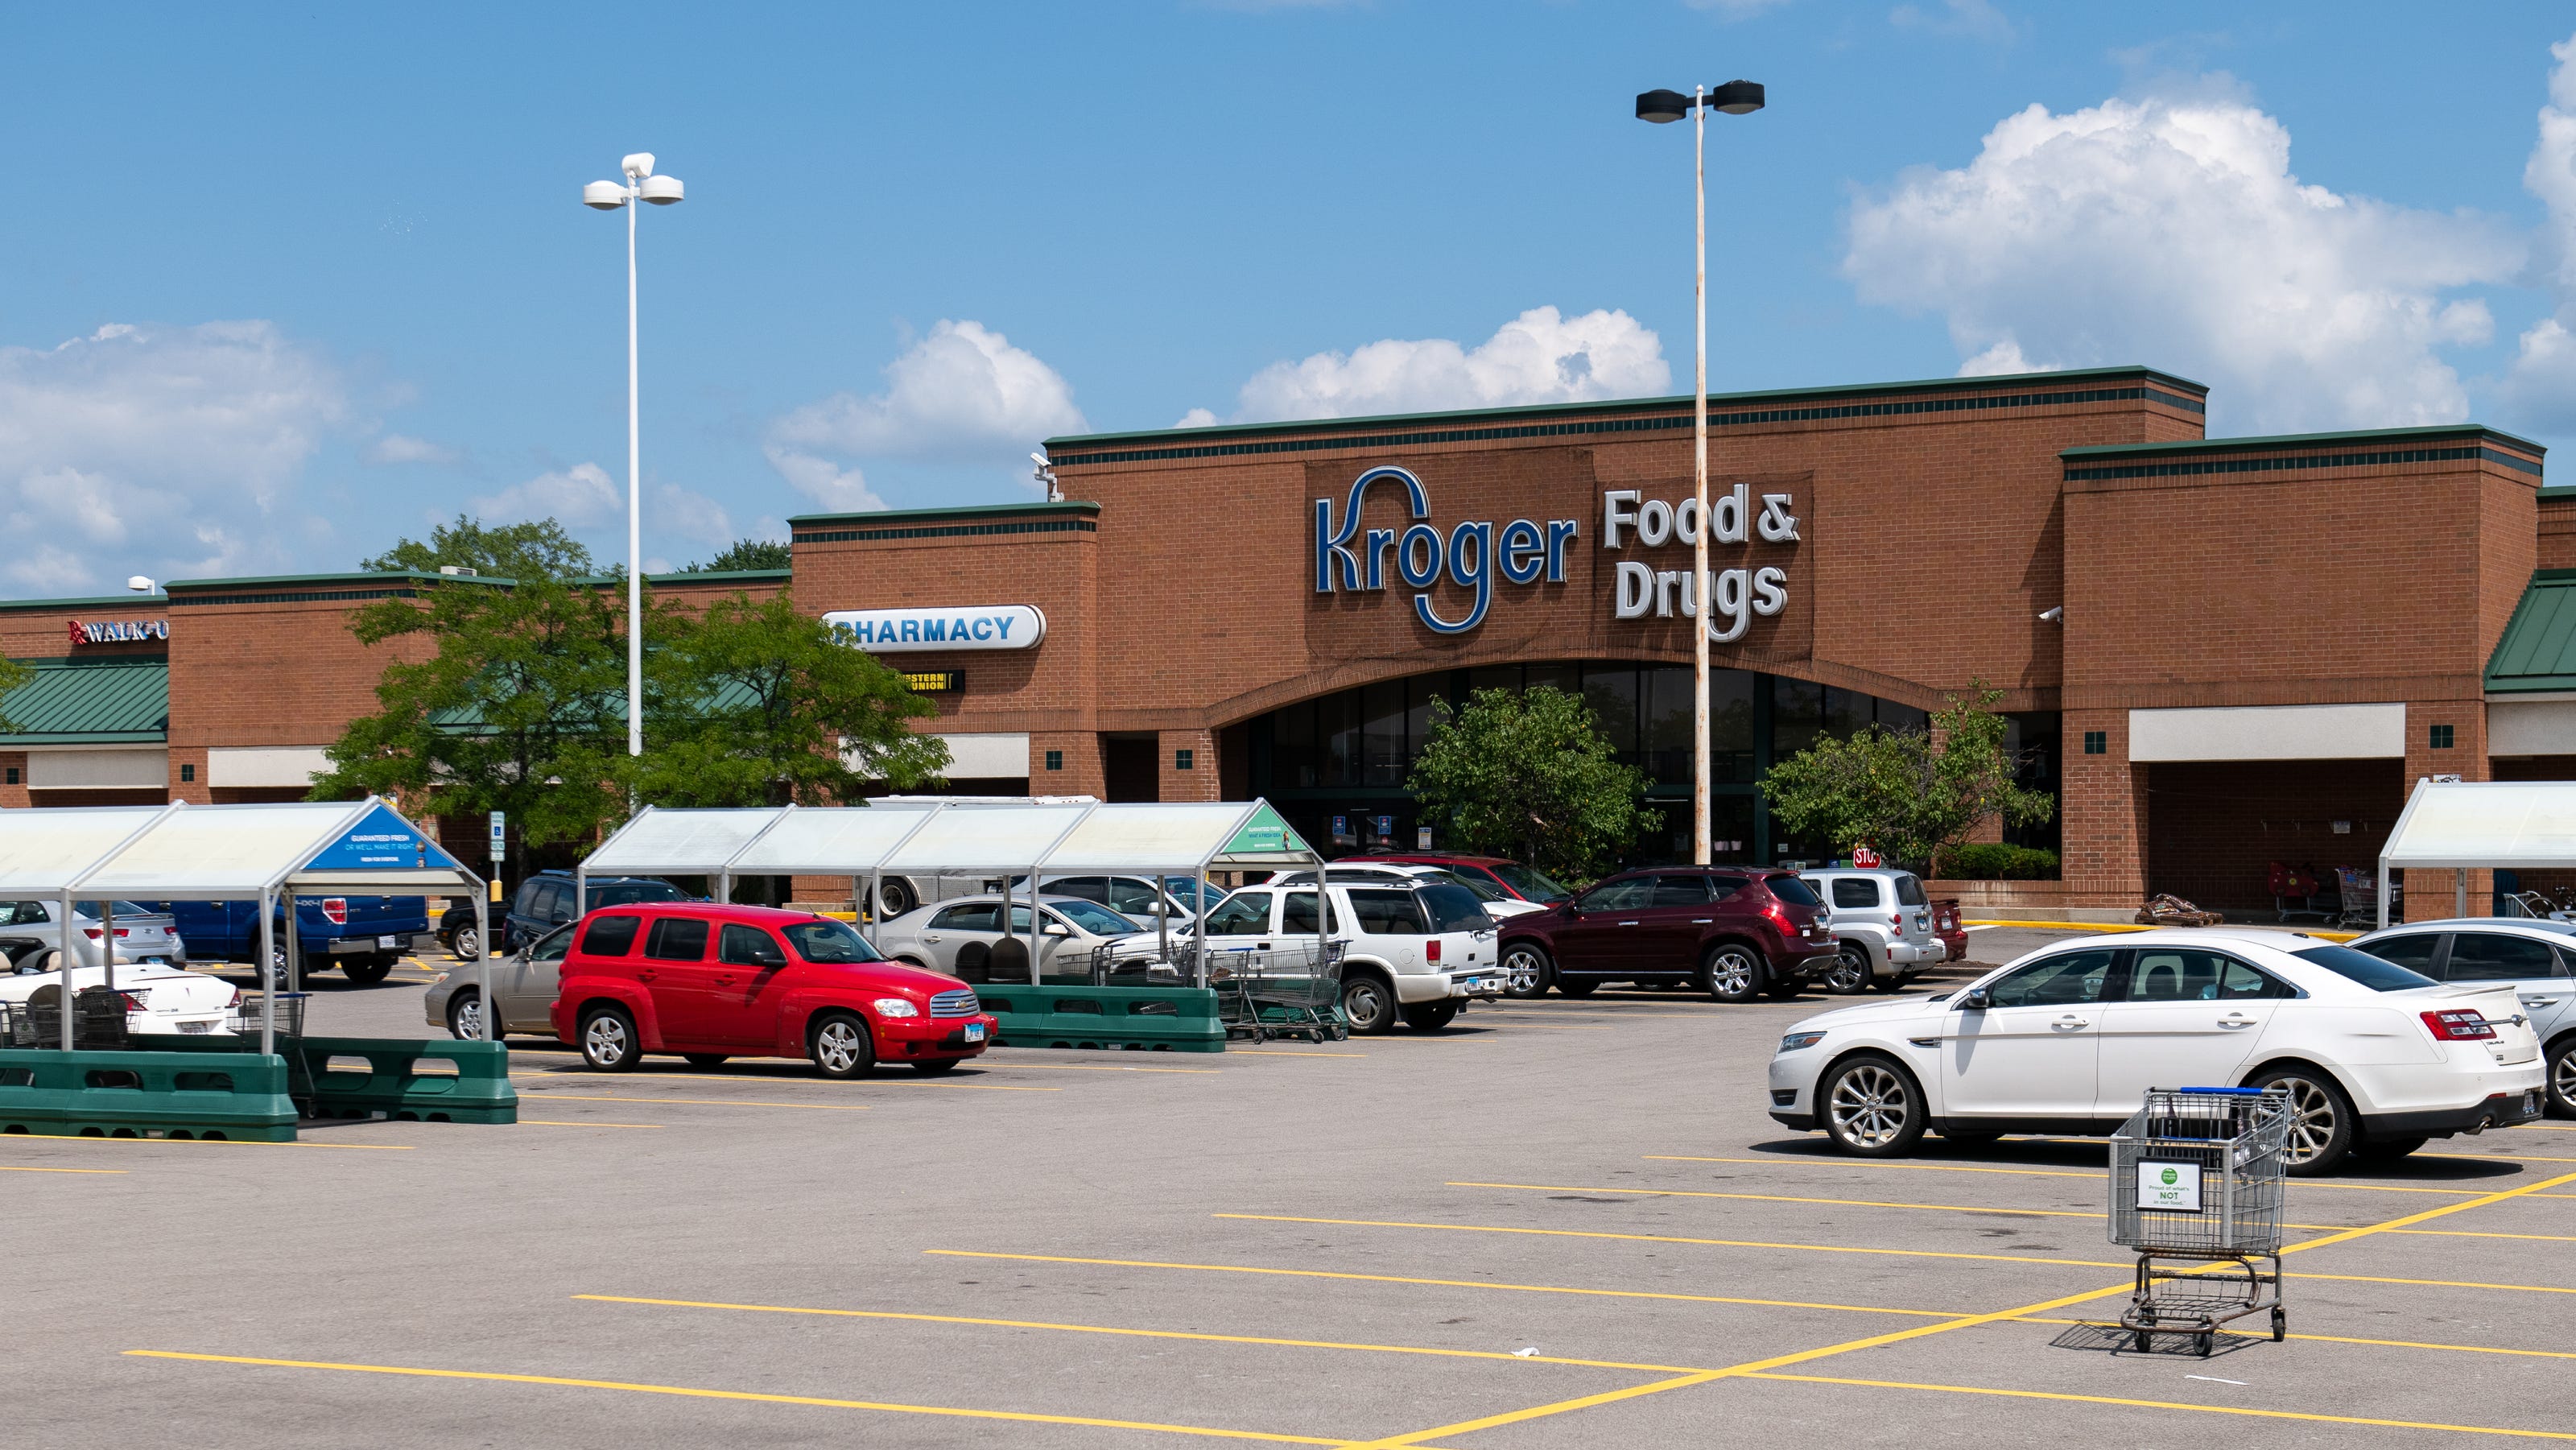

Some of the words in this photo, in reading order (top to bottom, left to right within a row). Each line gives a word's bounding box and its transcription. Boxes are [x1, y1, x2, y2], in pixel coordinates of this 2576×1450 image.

[1315, 465, 1580, 634] Kroger
[1604, 483, 1750, 550] Food
[1757, 494, 1802, 543] &
[1616, 561, 1789, 643] Drugs
[911, 681, 944, 691] UNION
[2160, 1192, 2179, 1200] NOT
